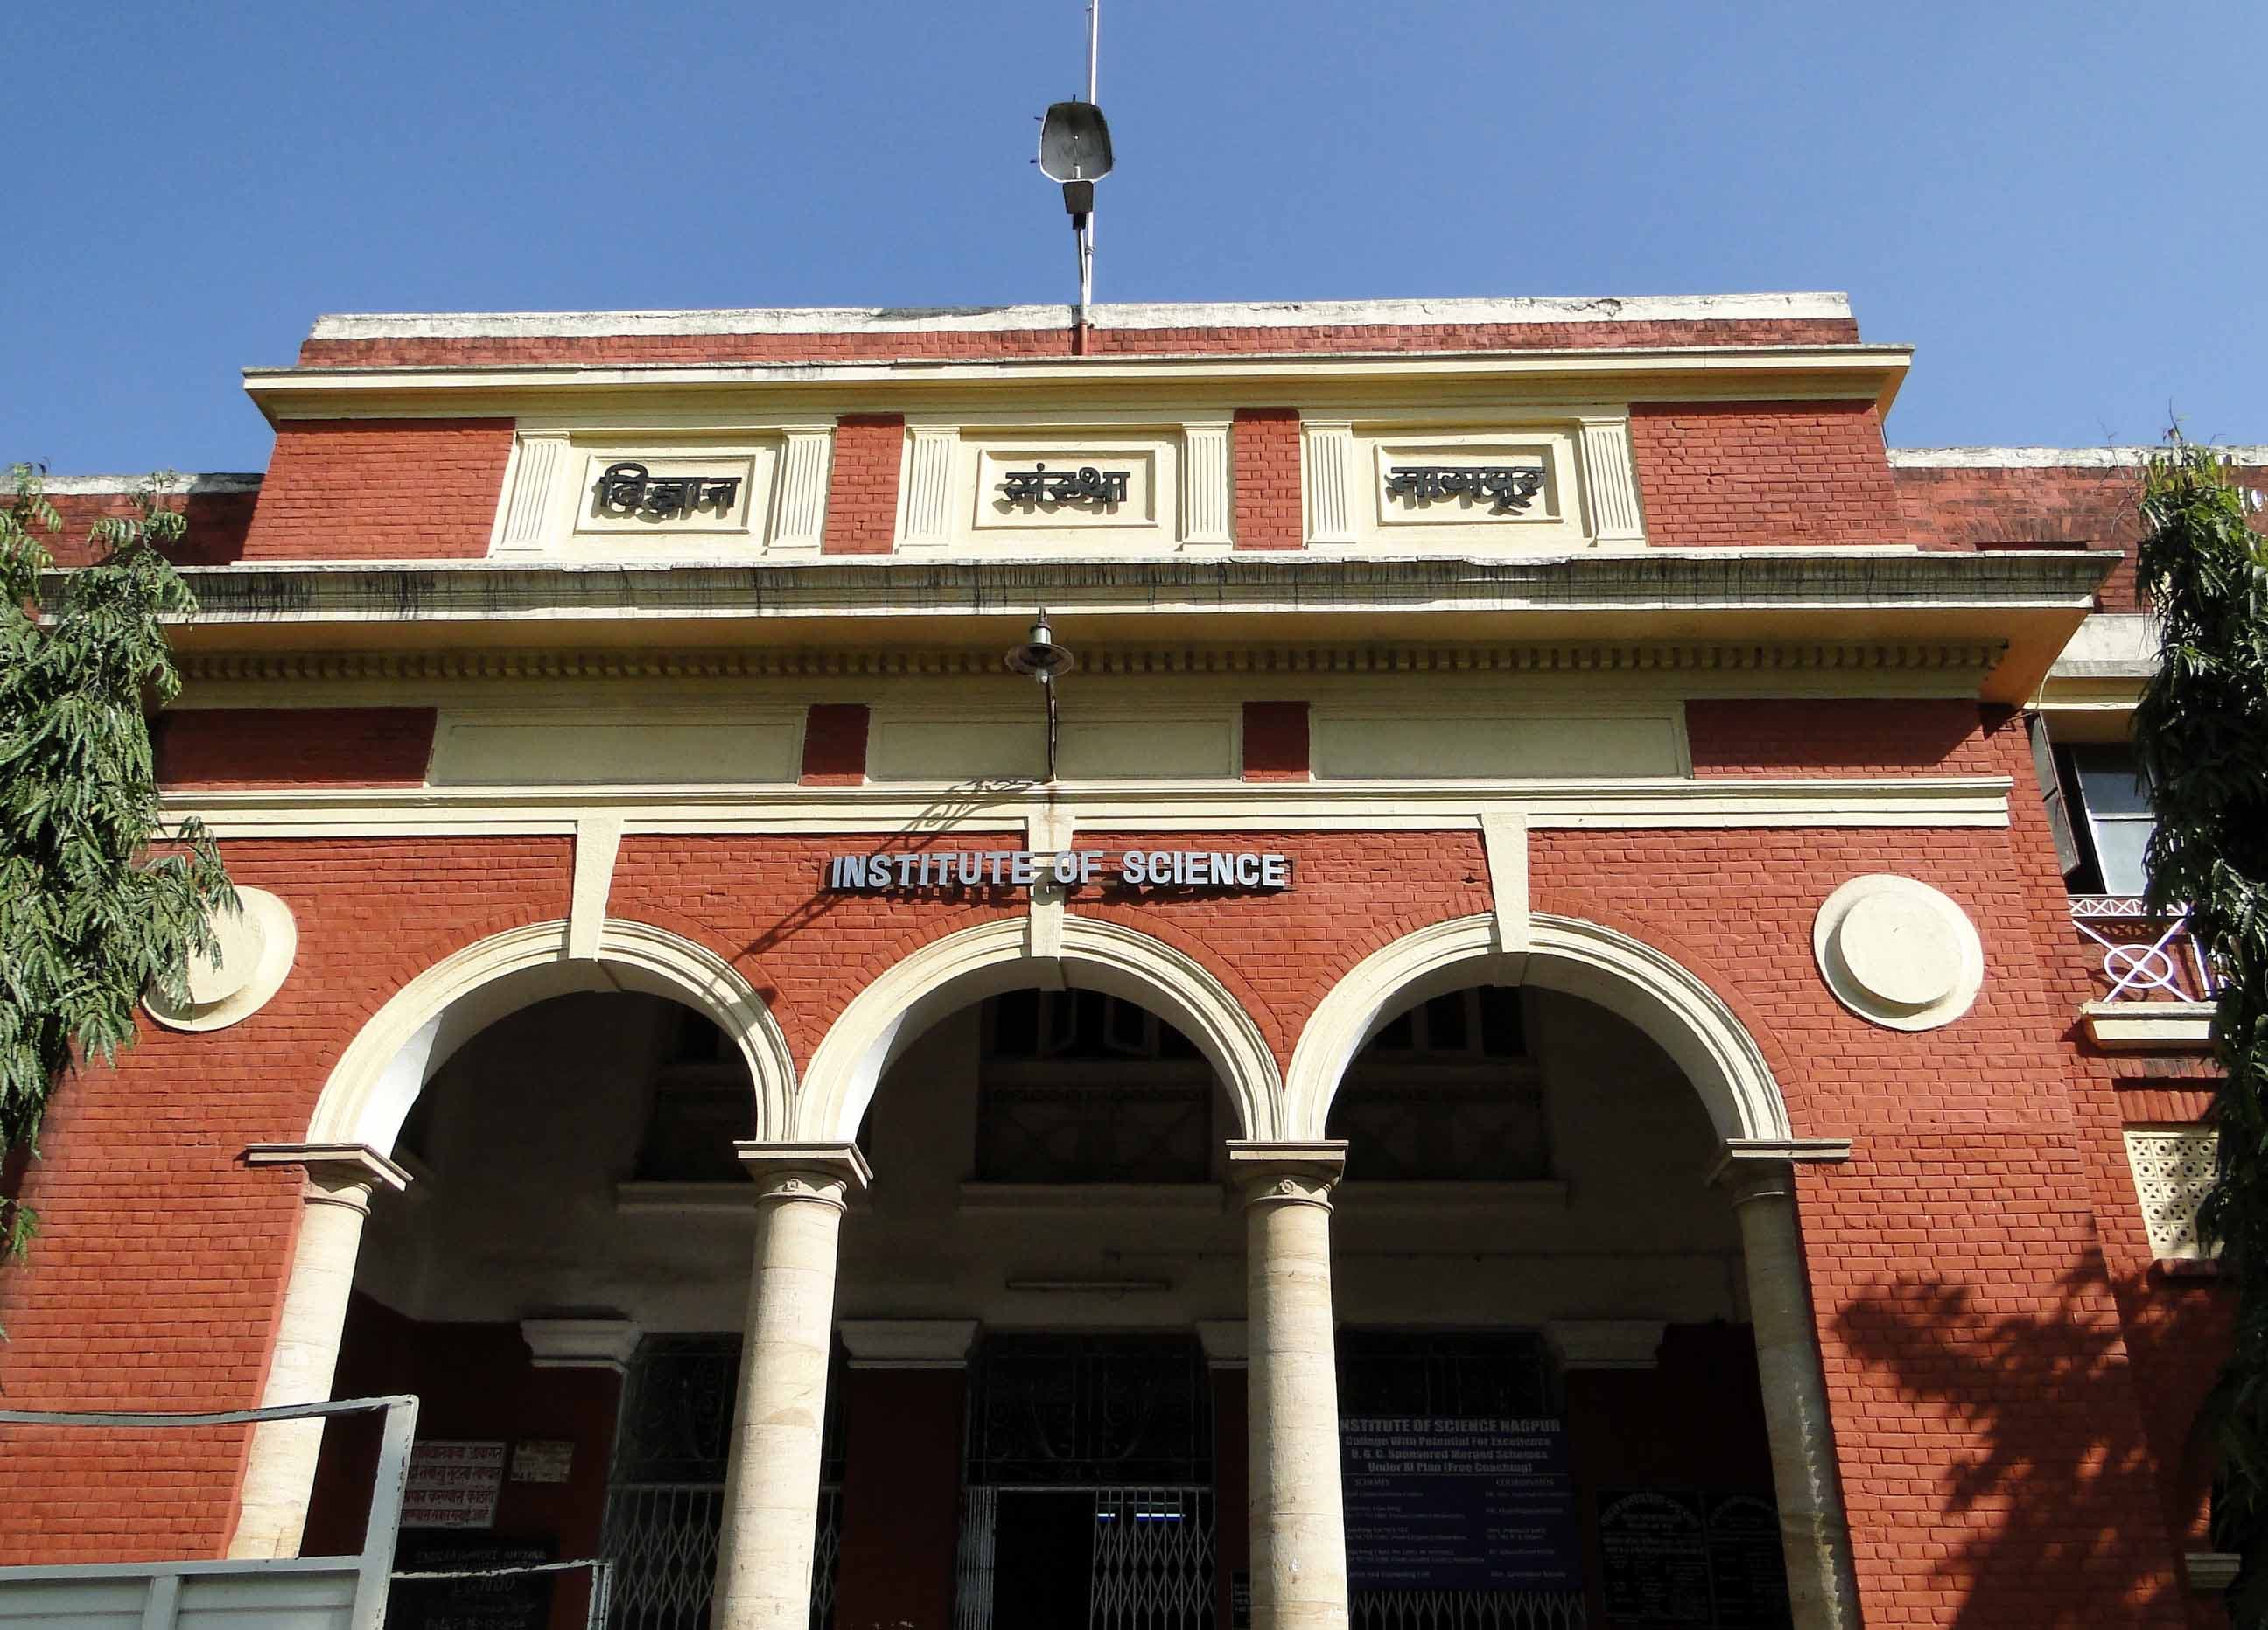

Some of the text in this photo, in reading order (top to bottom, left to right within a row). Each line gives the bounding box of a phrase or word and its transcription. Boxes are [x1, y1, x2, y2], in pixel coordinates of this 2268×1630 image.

[600, 463, 742, 510] विज्ञान
[1004, 462, 1130, 503] संस्था
[1385, 466, 1546, 508] नागपूर
[832, 850, 1285, 889] INSTITUTE OF SCIENCE
[1341, 1419, 1411, 1432] NSTITUTE
[1414, 1419, 1429, 1432] OF
[1435, 1419, 1497, 1432] SCIENCE
